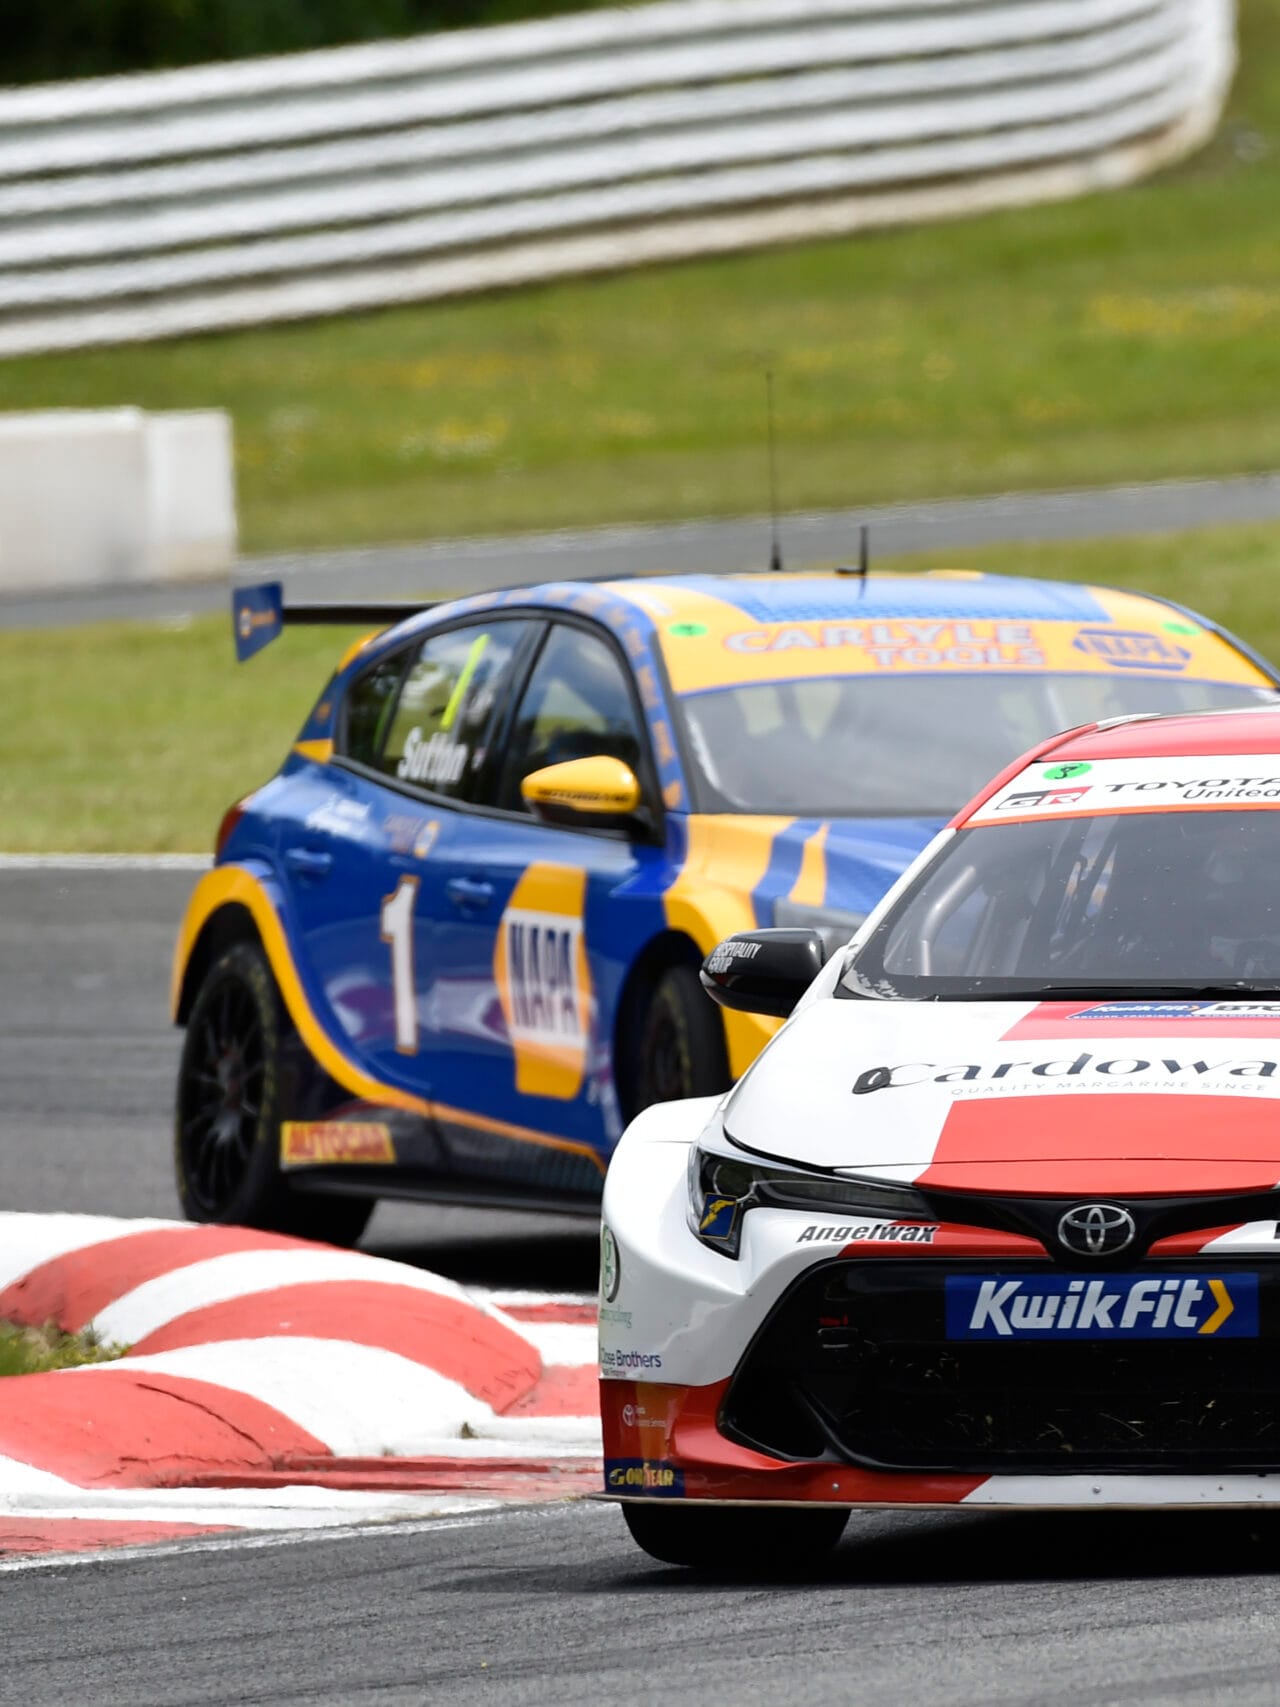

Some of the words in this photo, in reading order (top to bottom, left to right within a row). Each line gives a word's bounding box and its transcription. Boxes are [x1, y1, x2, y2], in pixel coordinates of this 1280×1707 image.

[724, 623, 1034, 654] CARLYLE
[867, 647, 1045, 667] TOOLS
[440, 633, 490, 730] 1
[397, 726, 467, 784] Sutton
[380, 873, 420, 1057] 1
[509, 922, 581, 1036] NAPA
[951, 1081, 1046, 1096] QUALITY
[1056, 1080, 1189, 1089] MARGARINE
[1208, 1081, 1266, 1091] SINCE
[796, 1224, 940, 1244] Angelwax
[616, 1349, 662, 1368] Brothers
